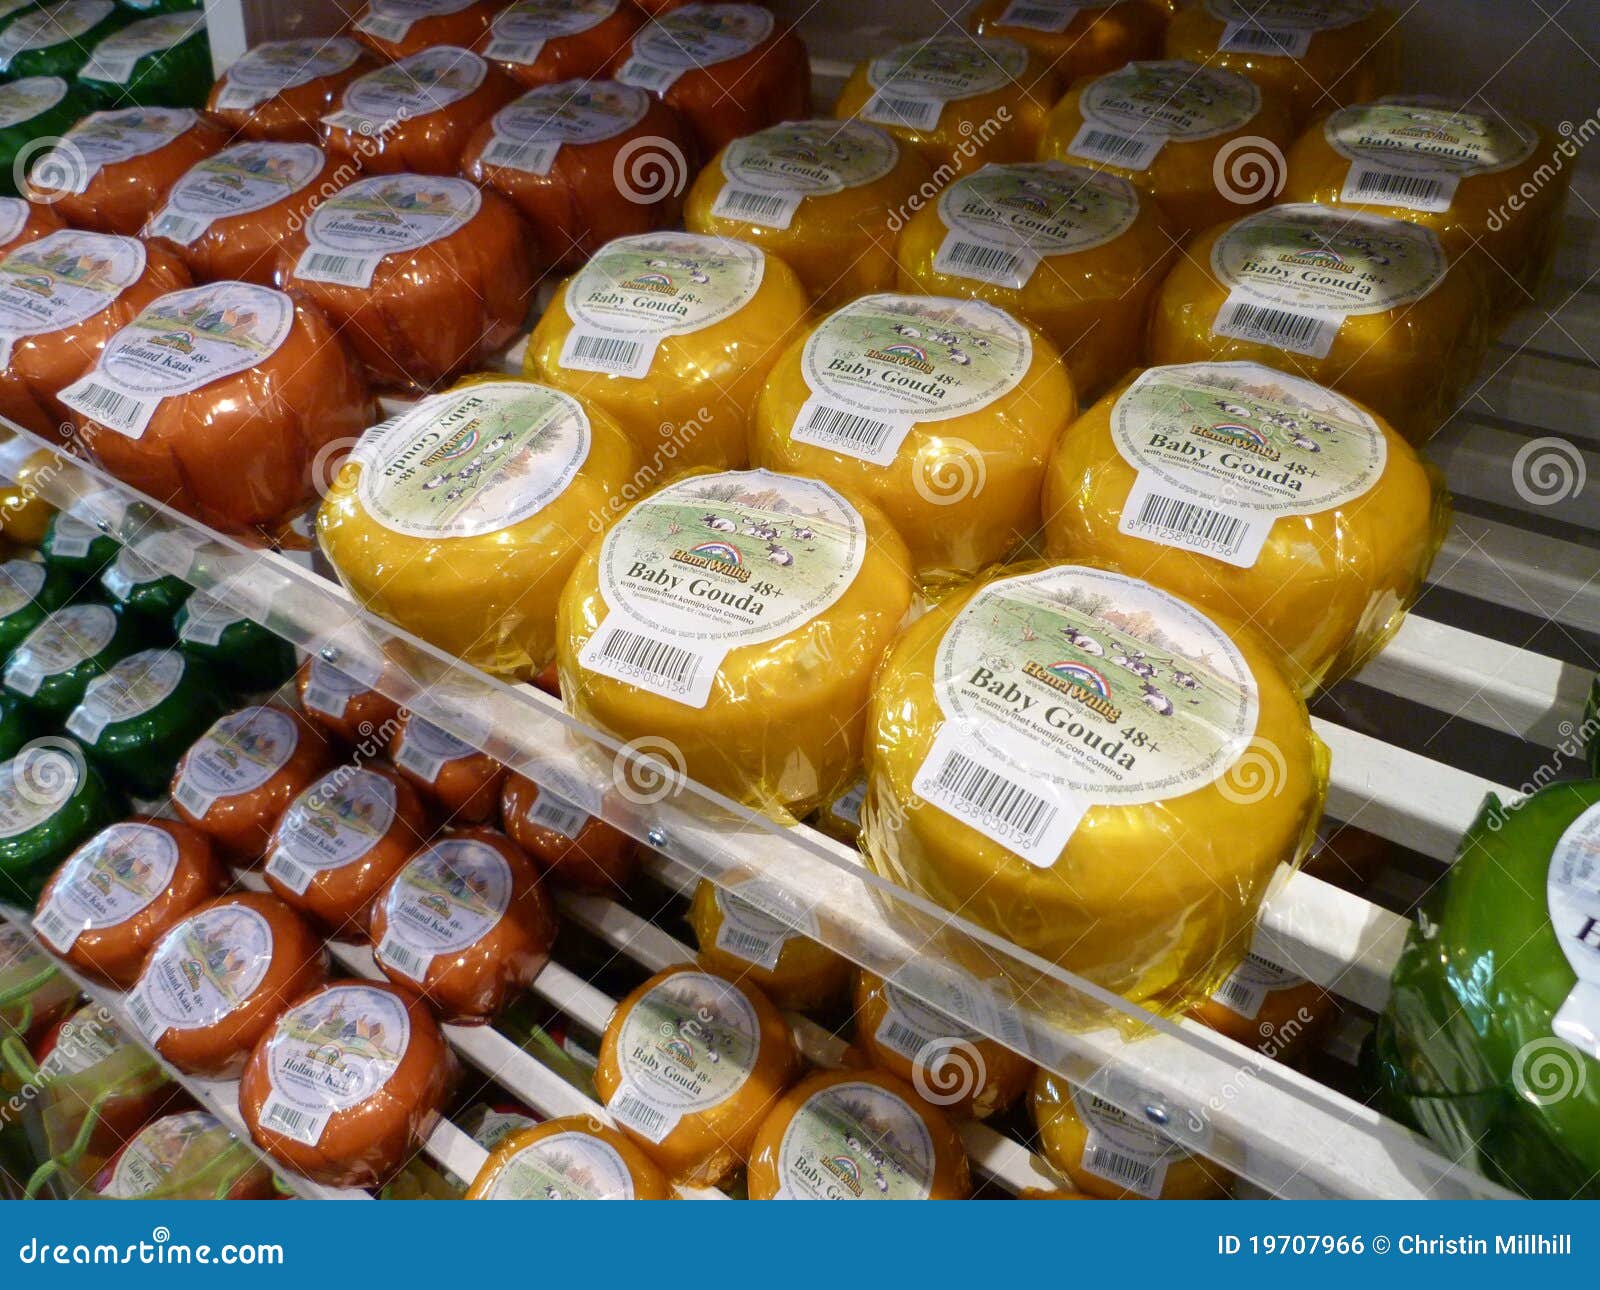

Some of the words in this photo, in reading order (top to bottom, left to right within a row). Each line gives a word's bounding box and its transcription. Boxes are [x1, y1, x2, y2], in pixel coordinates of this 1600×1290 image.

[1358, 136, 1406, 149] Baby
[1413, 142, 1479, 161] Gouda
[780, 161, 830, 181] Gouda
[325, 221, 374, 233] Holland
[961, 202, 1002, 222] Baby
[1011, 213, 1068, 239] Gouda
[1240, 261, 1292, 279] Baby
[1300, 270, 1372, 296] Gouda
[587, 291, 627, 309] Baby
[633, 296, 688, 317] Gouda
[116, 343, 161, 363] Holland
[163, 355, 194, 373] Kaas
[864, 348, 900, 365] Henri
[828, 359, 878, 379] Baby
[881, 370, 947, 399] Gouda
[934, 374, 963, 387] 48+
[440, 397, 484, 430] Baby
[1189, 424, 1233, 446] Henri
[384, 432, 441, 478] Gouda
[1148, 433, 1213, 461] Baby
[1220, 453, 1303, 492] Gouda
[1283, 461, 1321, 479] 48+
[1262, 483, 1297, 499] comino
[670, 548, 711, 570] Henri
[709, 559, 752, 584] Willig
[620, 579, 637, 590] with
[723, 609, 755, 626] comino
[626, 561, 684, 592] Baby
[689, 579, 765, 616] Gouda
[750, 580, 785, 599] 48+
[1022, 660, 1071, 695] Henri
[1069, 684, 1123, 724] Willig
[967, 666, 1041, 713] Baby
[1044, 705, 1137, 771] Gouda
[960, 686, 981, 702] with
[980, 697, 1031, 728] cumin/met
[1031, 718, 1086, 759] komijn/con
[1086, 754, 1124, 782] comino
[1119, 726, 1161, 754] 48+
[431, 918, 453, 938] Kaas
[161, 957, 184, 991] Holland
[177, 989, 193, 1014] Kaas
[283, 1058, 325, 1080] Holland
[632, 1046, 661, 1072] Baby
[664, 1063, 703, 1096] Gouda
[1092, 1096, 1128, 1122] Baby
[793, 1156, 826, 1189] Baby
[820, 1155, 843, 1178] Henri
